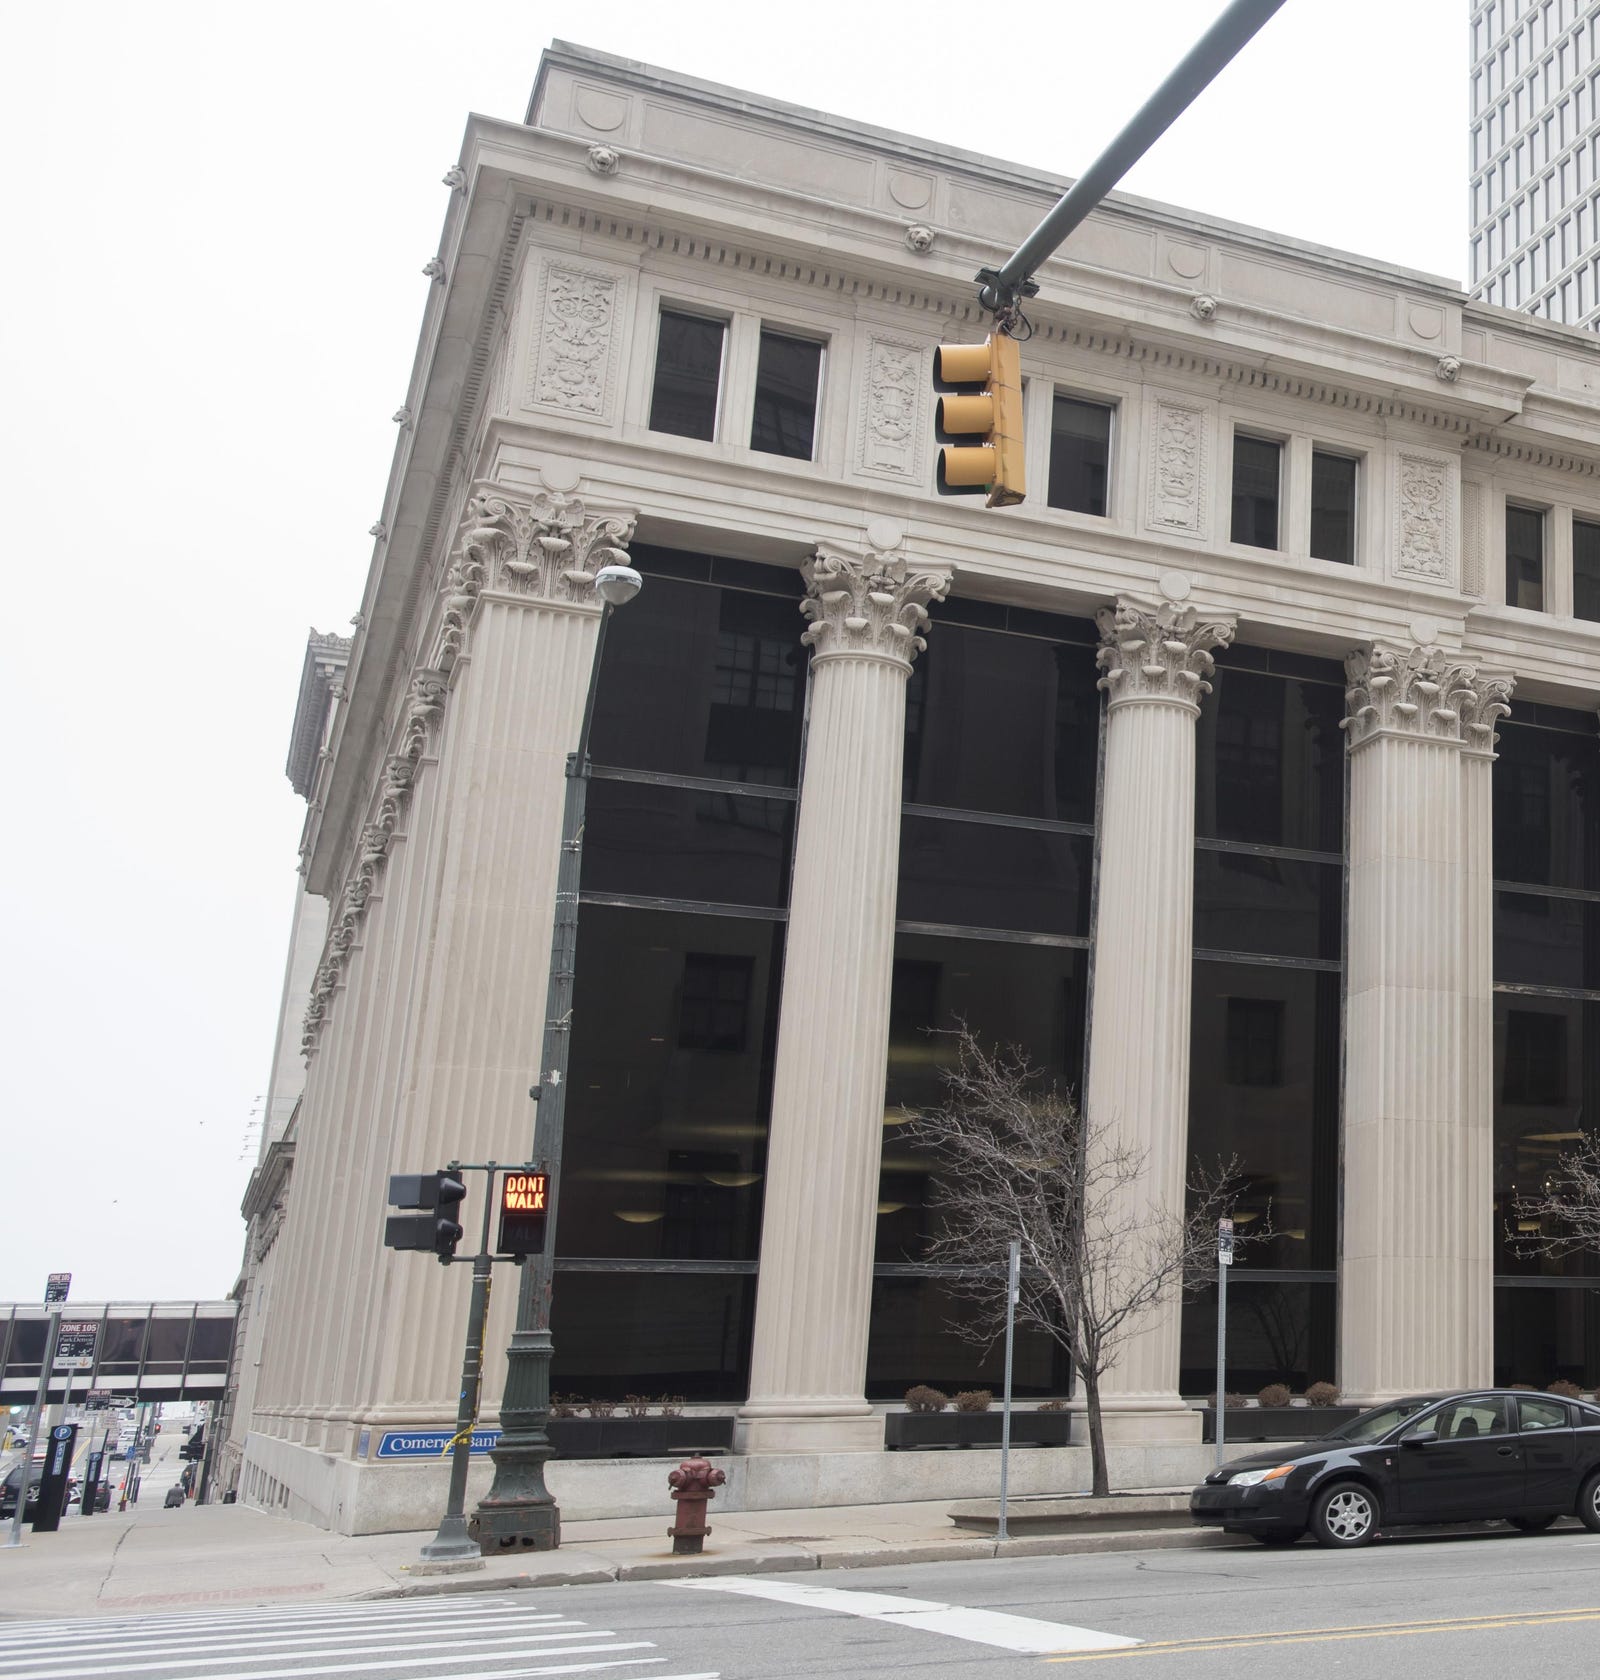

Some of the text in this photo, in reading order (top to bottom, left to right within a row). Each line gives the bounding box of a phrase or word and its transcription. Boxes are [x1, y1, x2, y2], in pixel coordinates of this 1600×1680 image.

[506, 1176, 545, 1193] DONT
[505, 1192, 545, 1209] WALK
[60, 1324, 97, 1332] ZONE 105
[59, 1427, 68, 1438] P
[390, 1437, 456, 1452] Comeric
